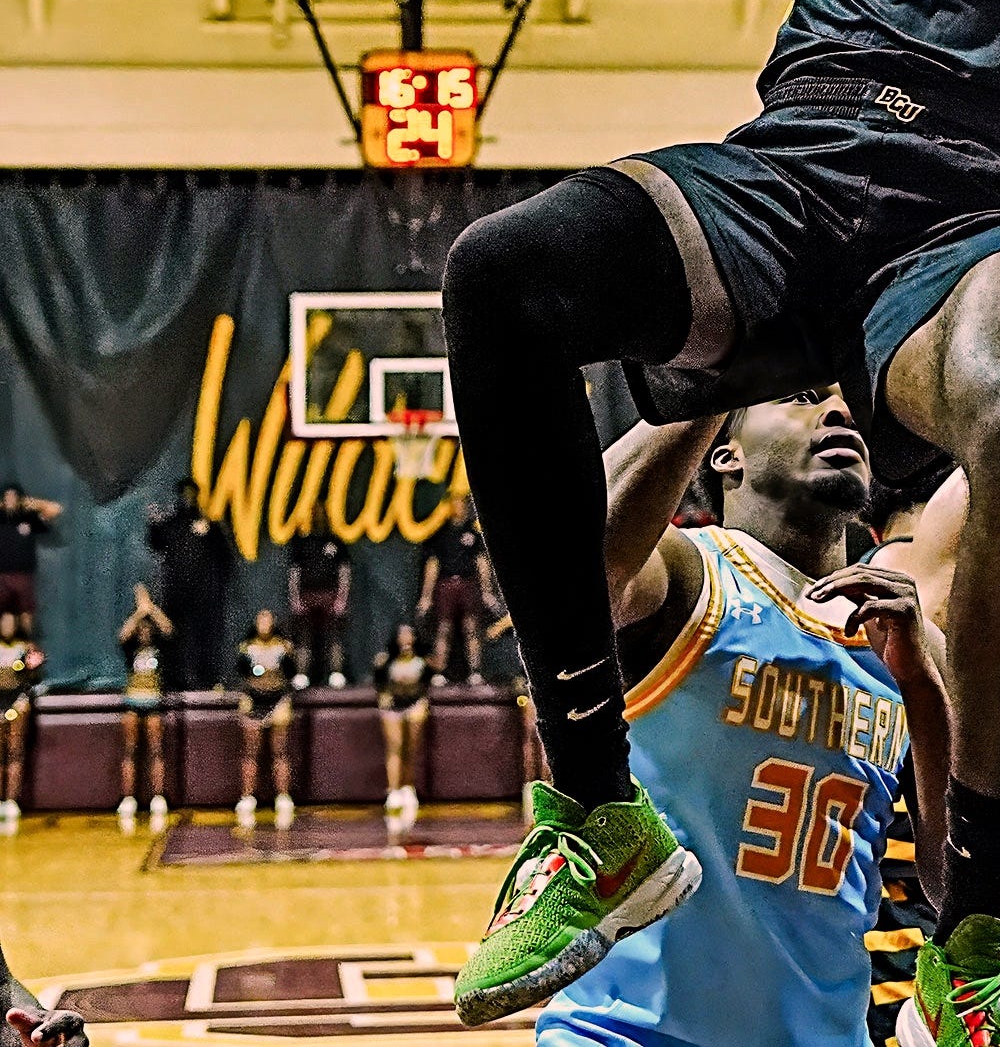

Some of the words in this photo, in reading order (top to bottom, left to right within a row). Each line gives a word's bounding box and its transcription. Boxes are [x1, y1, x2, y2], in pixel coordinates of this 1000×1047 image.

[875, 85, 926, 122] BCU
[386, 107, 453, 163] 24
[736, 757, 870, 896] 30
